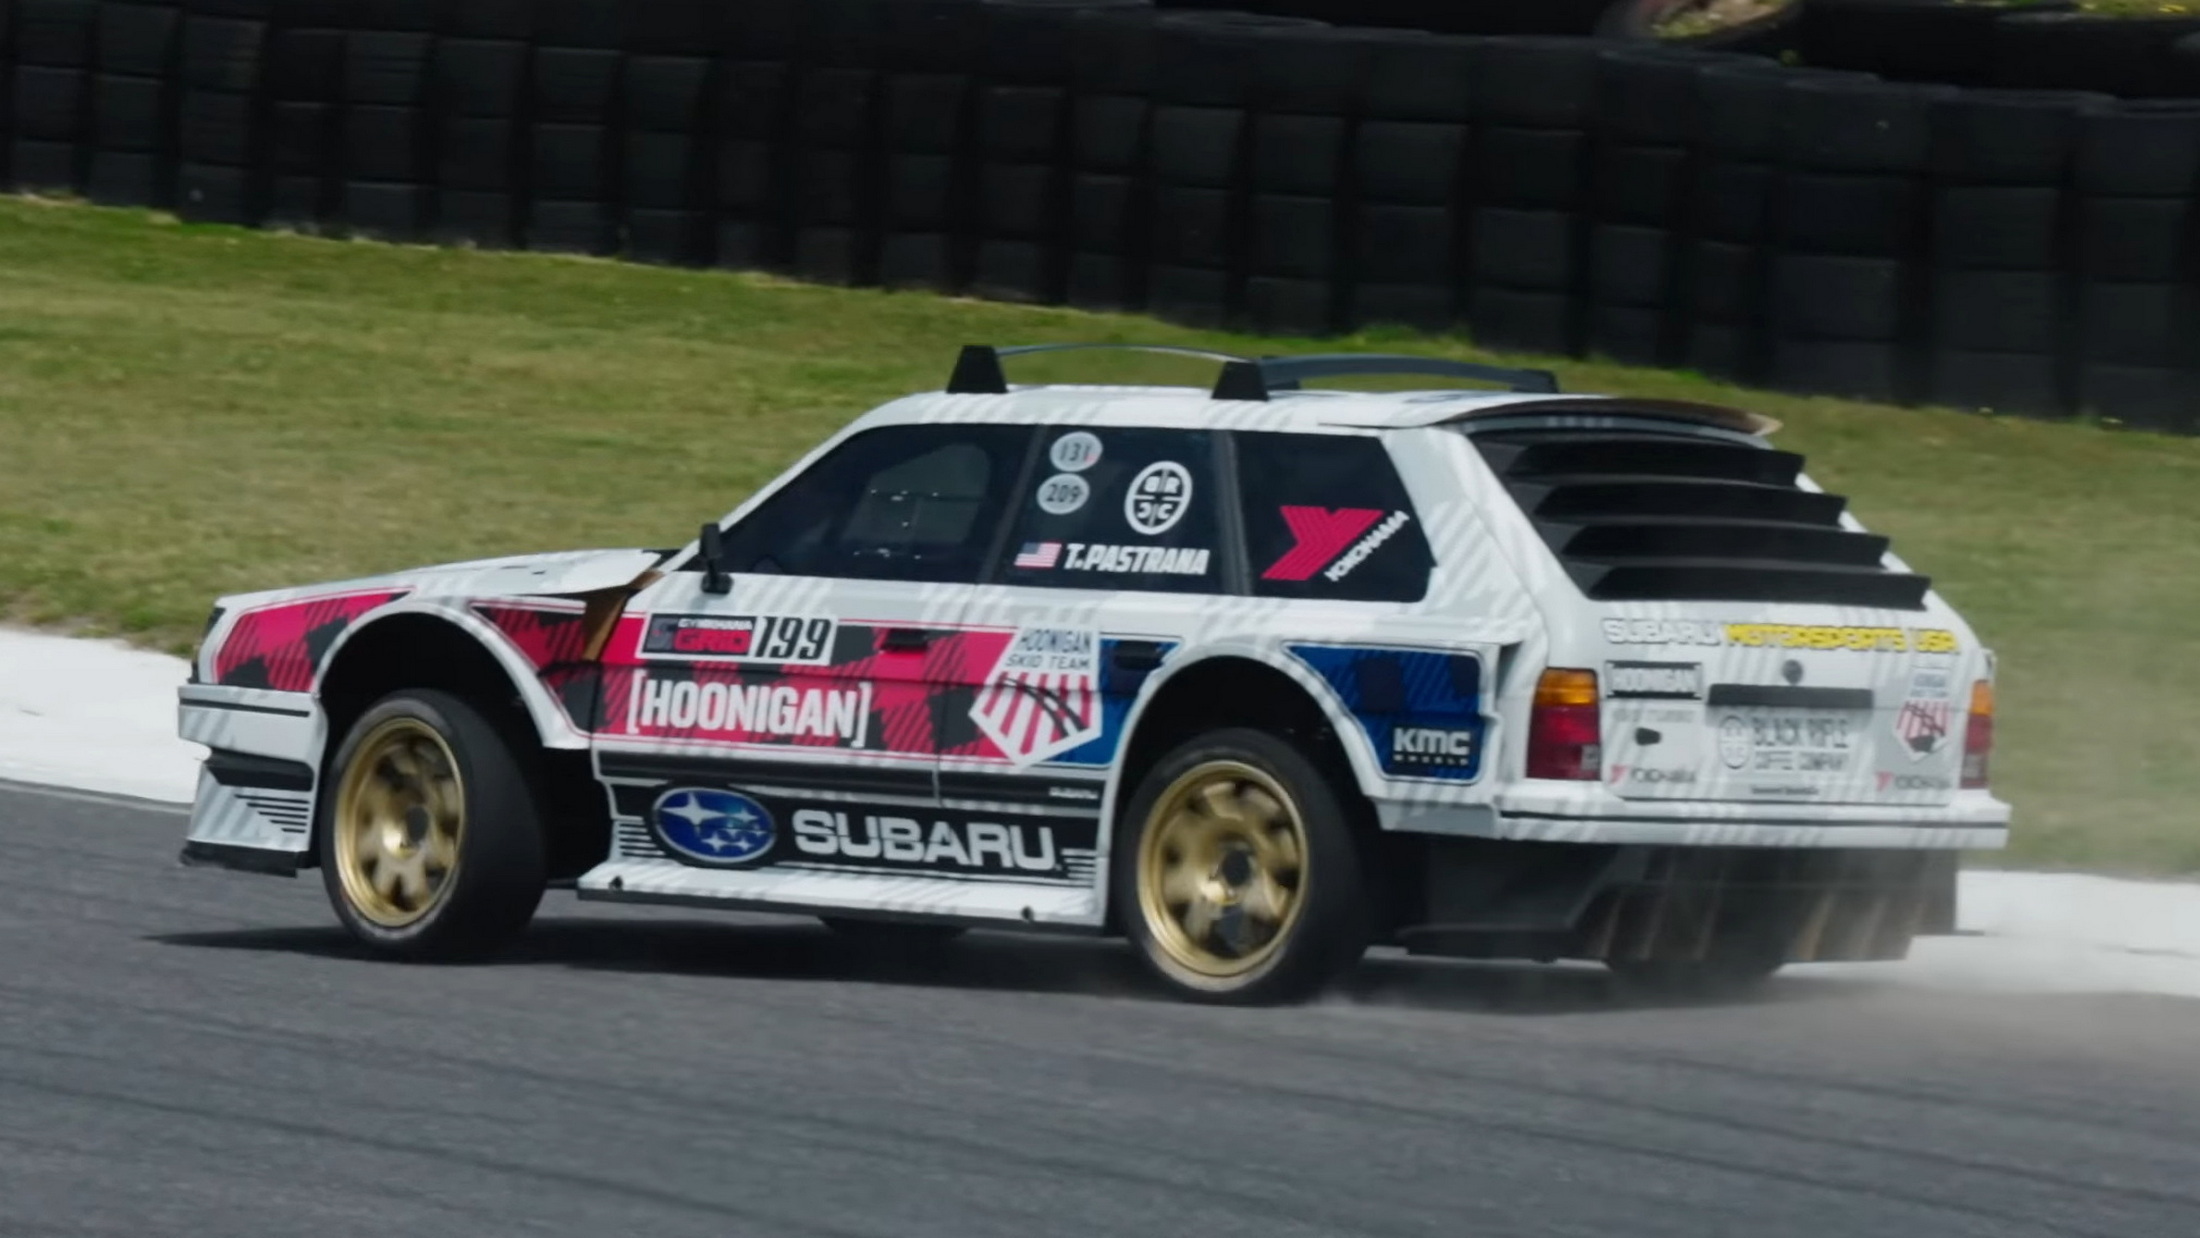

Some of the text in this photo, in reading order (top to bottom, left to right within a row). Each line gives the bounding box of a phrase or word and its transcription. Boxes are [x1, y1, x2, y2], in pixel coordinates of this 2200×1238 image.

[1059, 442, 1091, 463] 131
[1046, 483, 1083, 503] 209
[1064, 542, 1210, 575] T.PASTRANA
[755, 616, 831, 660] 199
[1602, 618, 1959, 653] SUBARU MOTORSPORTS USA
[1005, 653, 1090, 670] SKID TEAM
[1394, 727, 1470, 756] KMC
[792, 808, 1055, 871] SUBARU
